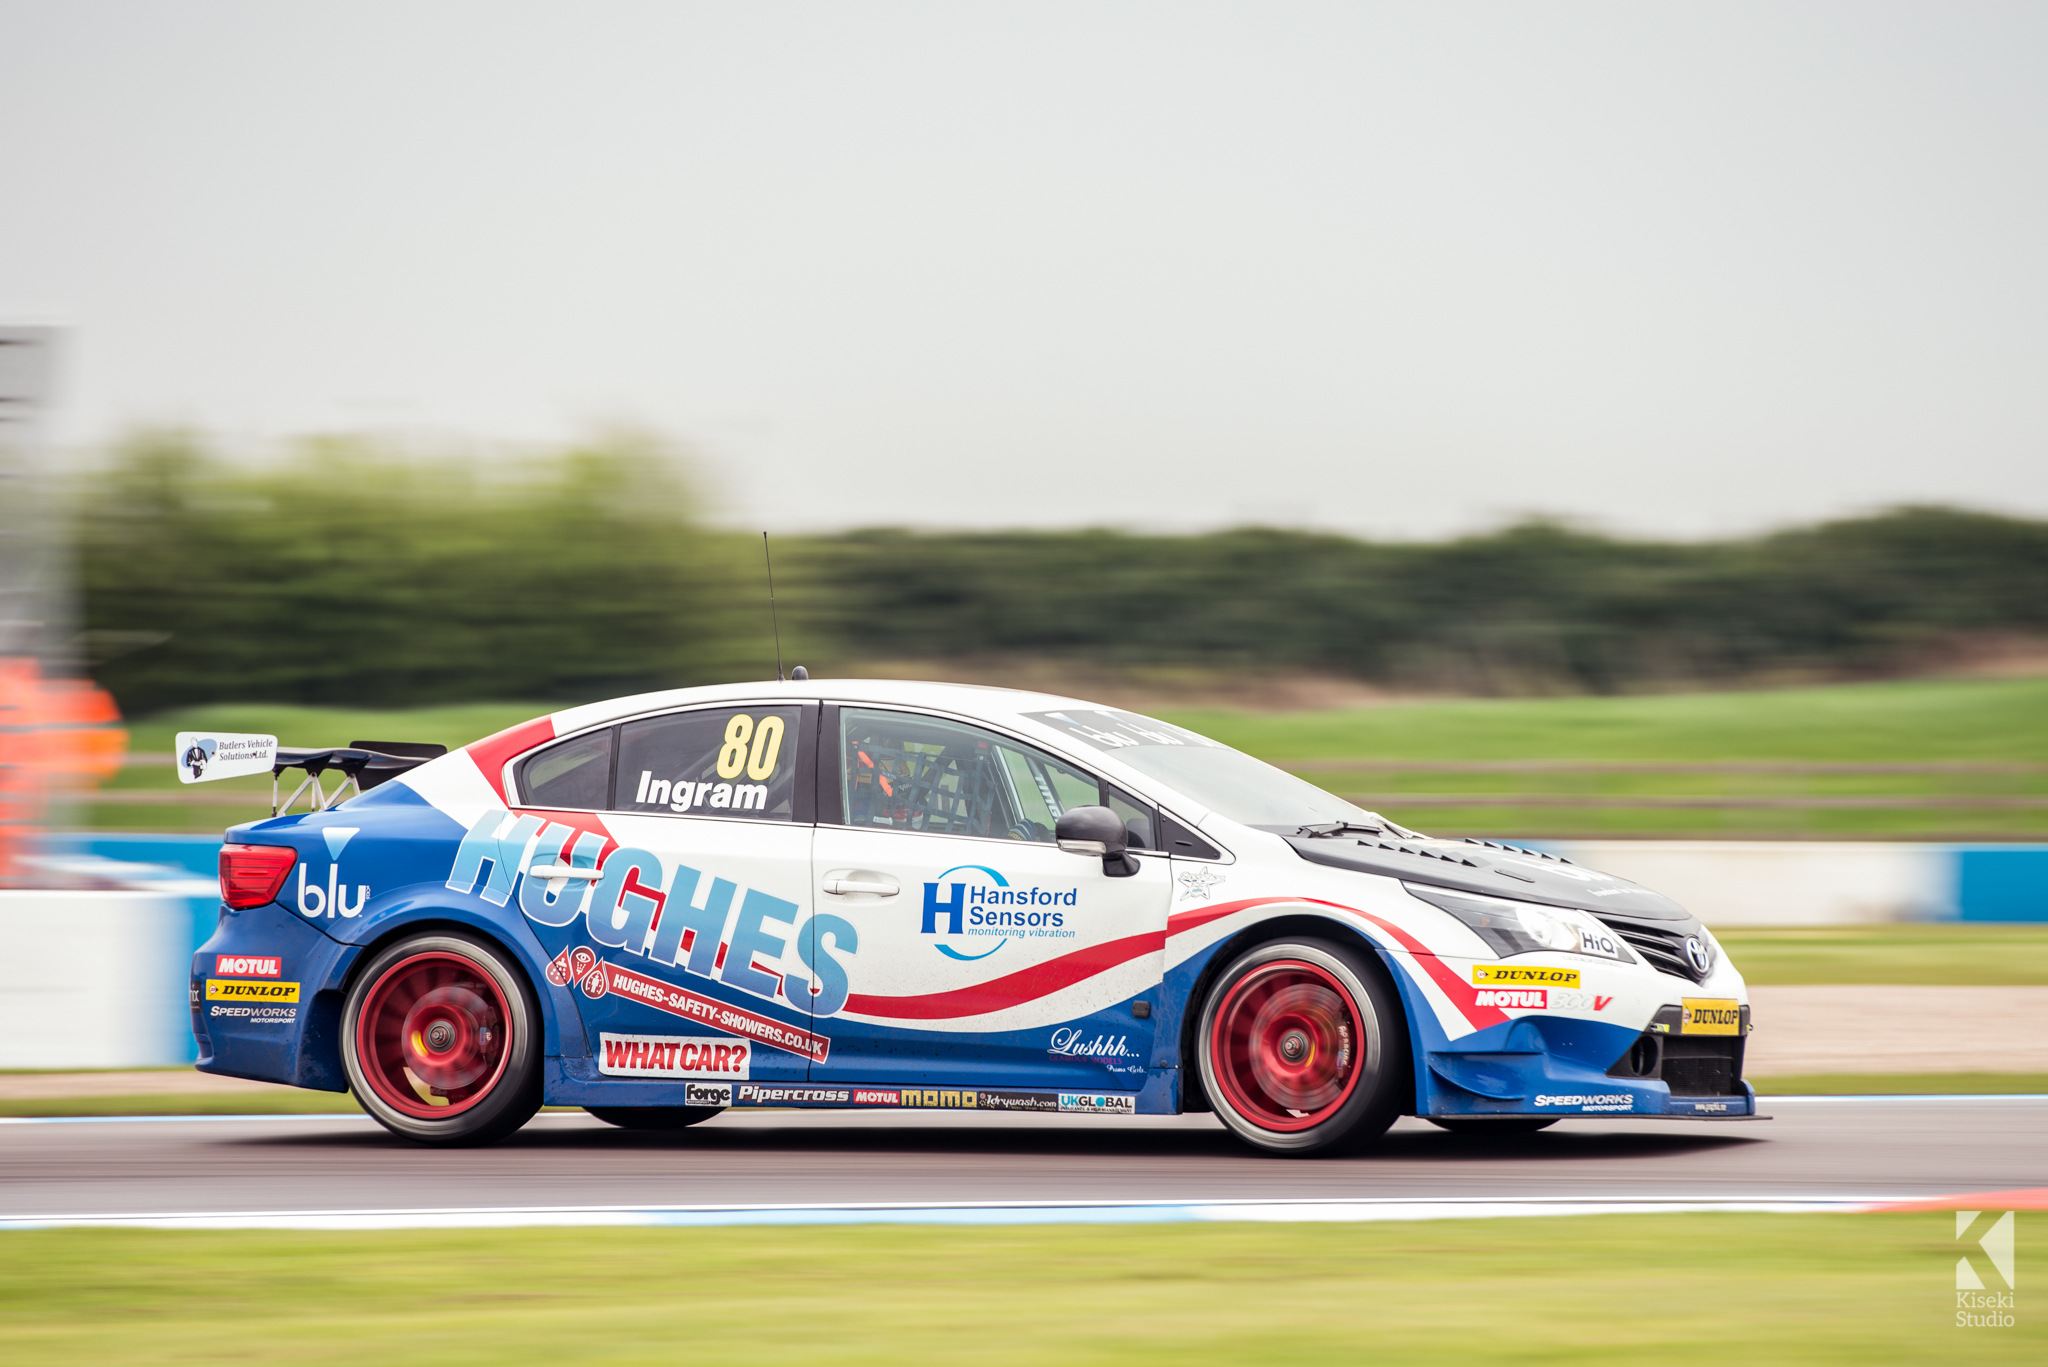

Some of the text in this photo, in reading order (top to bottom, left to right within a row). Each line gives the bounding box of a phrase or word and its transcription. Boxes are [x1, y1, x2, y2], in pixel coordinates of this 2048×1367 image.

[219, 739, 273, 750] Butlers Vehicle
[716, 713, 785, 781] 80
[219, 750, 268, 761] Solutions Ltd.
[635, 770, 768, 812] Ingram
[297, 862, 366, 918] blu
[970, 885, 1077, 906] Hansford
[445, 808, 859, 1019] HUGHES
[920, 882, 967, 934] H
[969, 906, 1064, 927] Sensors
[968, 926, 1076, 939] monitoring vibration
[1581, 932, 1615, 954] HiQ
[218, 958, 278, 975] MOTUL
[1493, 970, 1577, 982] DUNLOP
[222, 985, 296, 997] DUNLOP
[1475, 990, 1545, 1007] MOTUL
[210, 1006, 297, 1017] SPEEDWORKS
[612, 973, 824, 1056] HUGHES-SAFETY-SHOWERS.CO.UK
[1693, 1009, 1738, 1024] DUNLOP
[1090, 1057, 1122, 1065] MODELS
[738, 1085, 849, 1103] Pipercross
[855, 1091, 898, 1104] MOTUL
[1534, 1094, 1634, 1107] SPEEDWORKS
